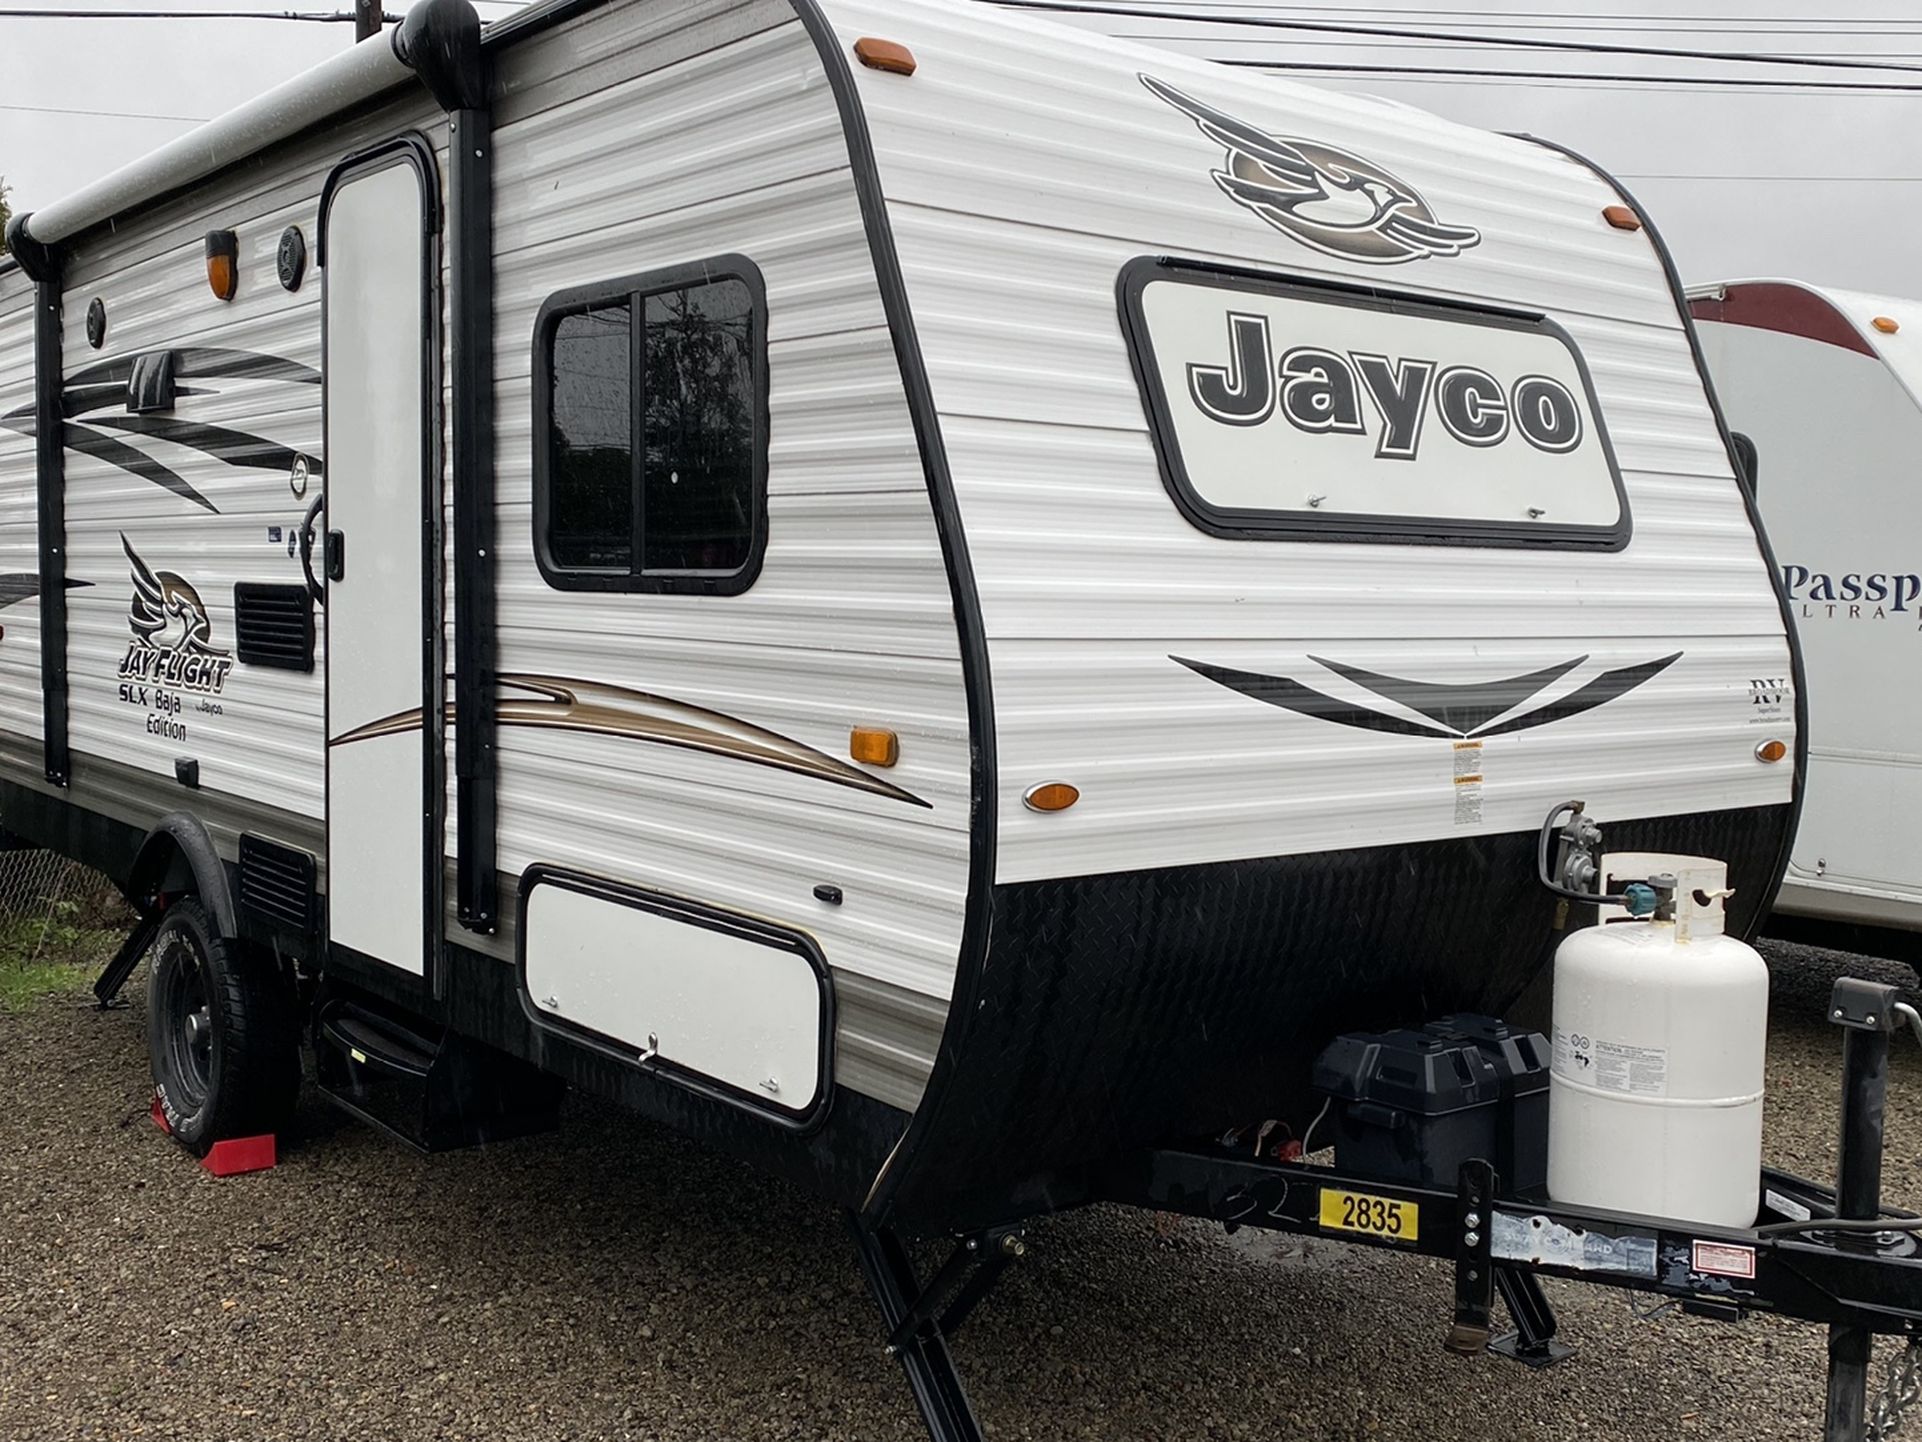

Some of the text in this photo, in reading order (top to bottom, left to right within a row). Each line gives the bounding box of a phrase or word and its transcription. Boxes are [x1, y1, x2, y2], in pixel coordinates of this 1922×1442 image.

[1186, 311, 1583, 461] Jayco
[1781, 565, 1921, 612] Passp
[118, 641, 233, 694] JAY FLIGHT
[119, 684, 148, 706] SLX
[155, 689, 181, 716] Baja
[146, 713, 187, 741] Edition
[1342, 1195, 1402, 1235] 2835
